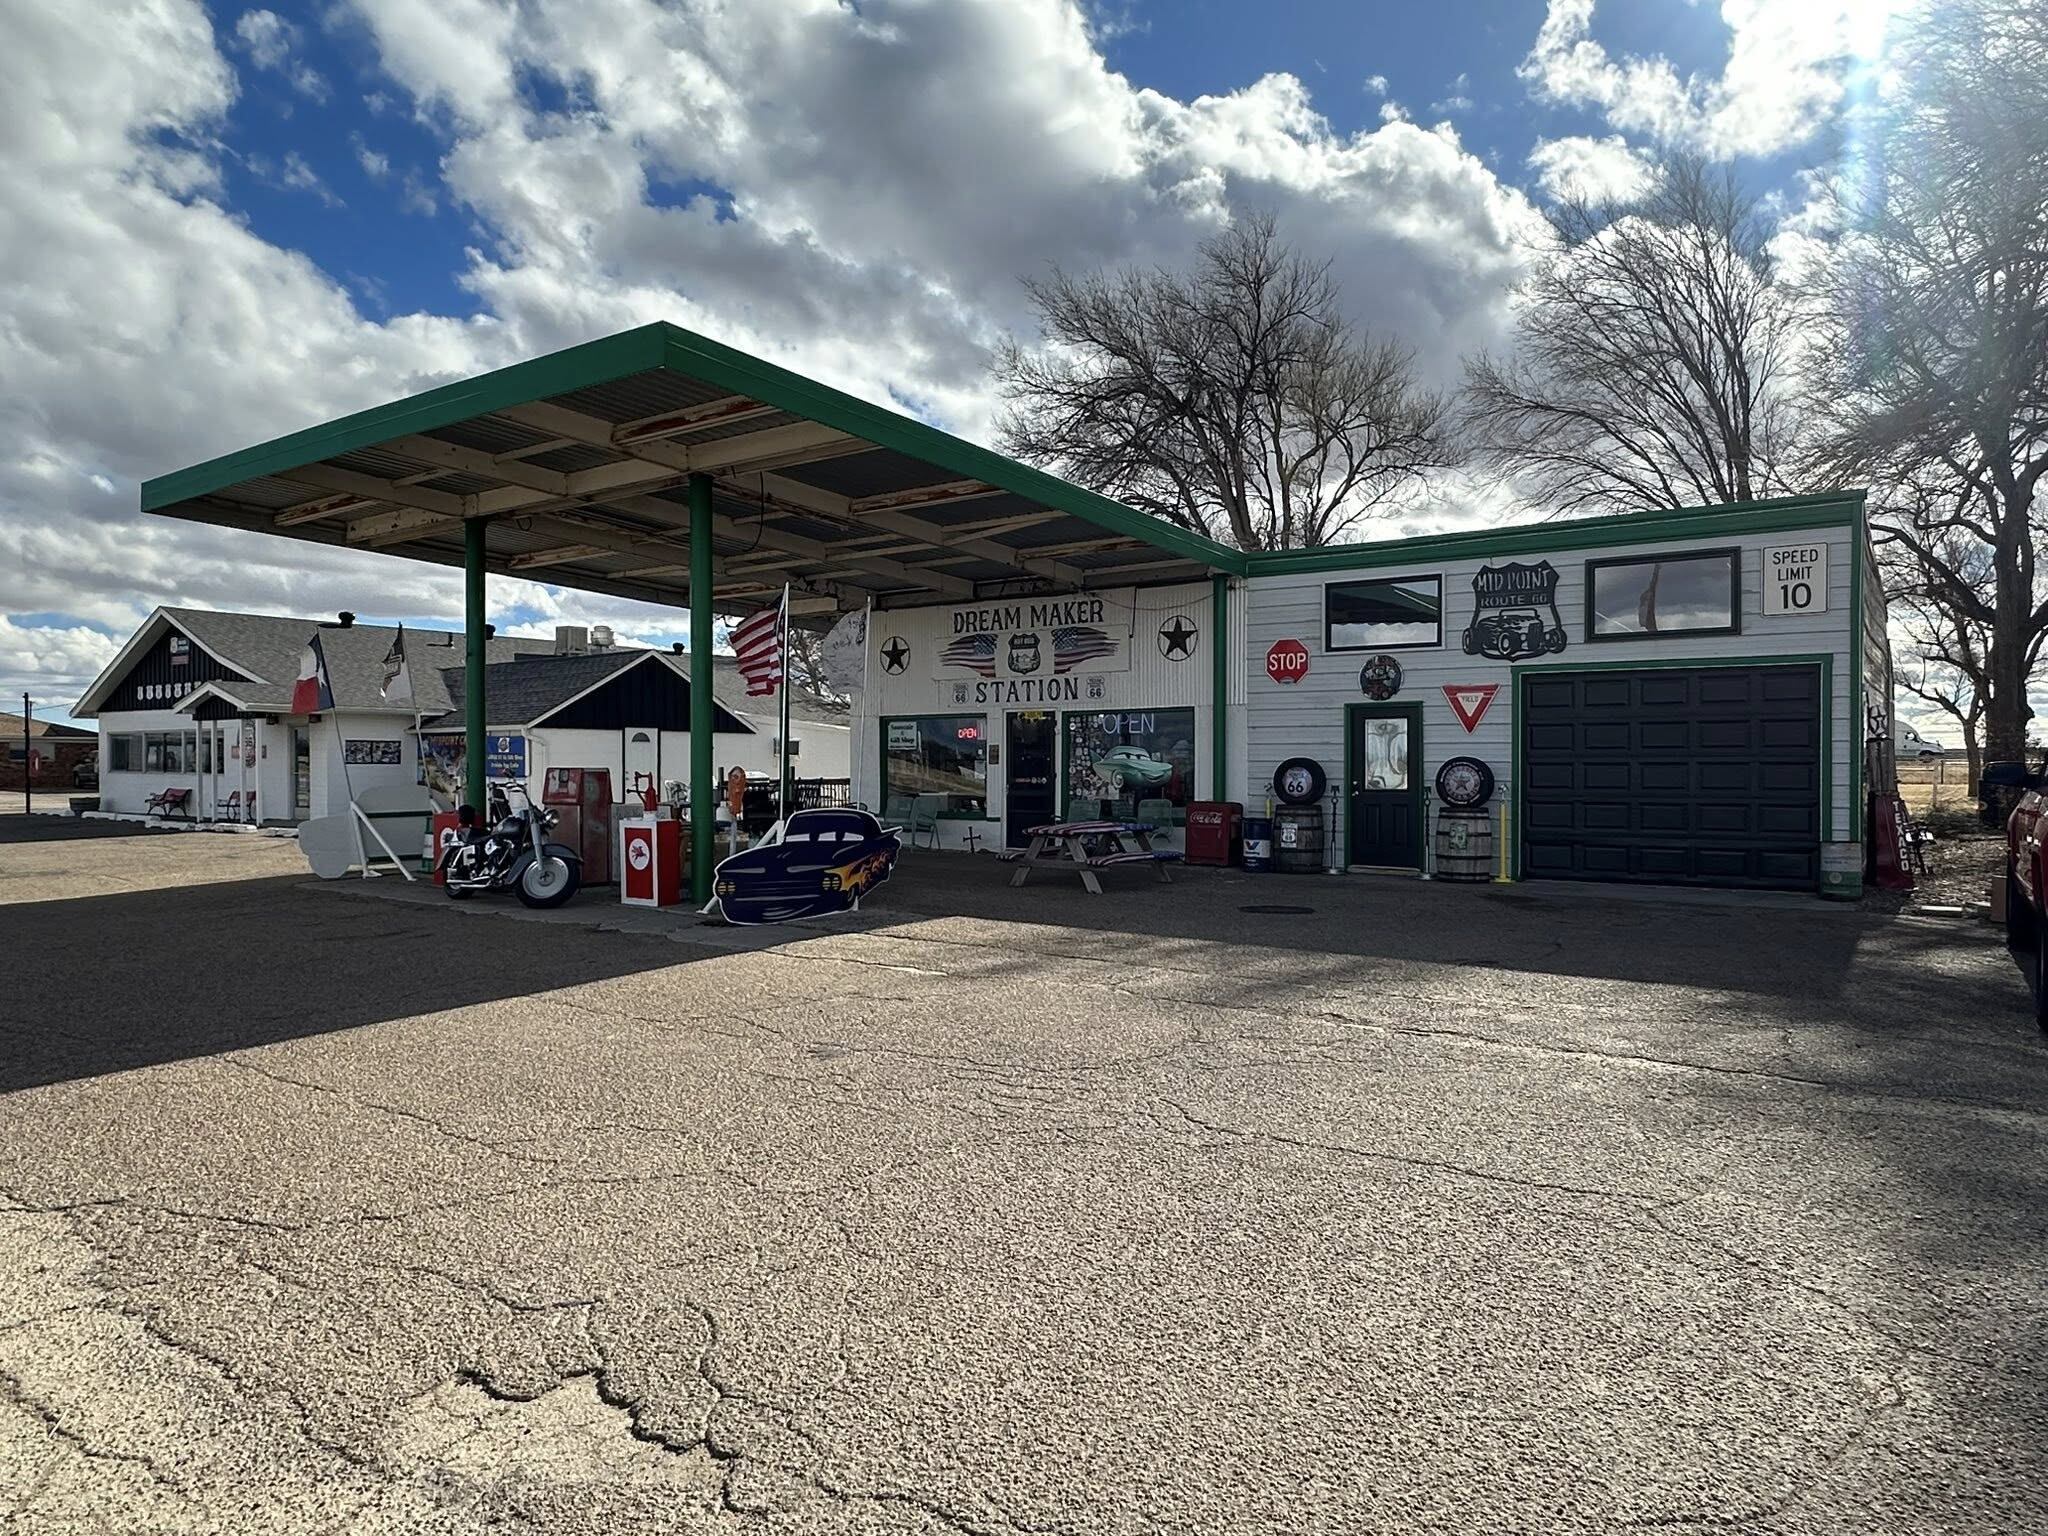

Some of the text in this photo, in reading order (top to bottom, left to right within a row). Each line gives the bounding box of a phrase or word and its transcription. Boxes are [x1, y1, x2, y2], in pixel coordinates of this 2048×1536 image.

[1773, 549, 1818, 565] SPEED
[1477, 568, 1551, 592] MID POINT
[1778, 566, 1813, 581] LIMIT
[1481, 594, 1526, 607] ROUTE
[1781, 582, 1812, 609] 10
[953, 599, 1104, 634] DREAM MAKER
[1269, 652, 1306, 671] STOP
[955, 693, 966, 703] 66
[975, 677, 1079, 704] STATION
[1089, 687, 1102, 698] 66
[1102, 713, 1155, 734] OPEN
[1287, 780, 1304, 793] 66
[1892, 801, 1910, 872] TEXACO
